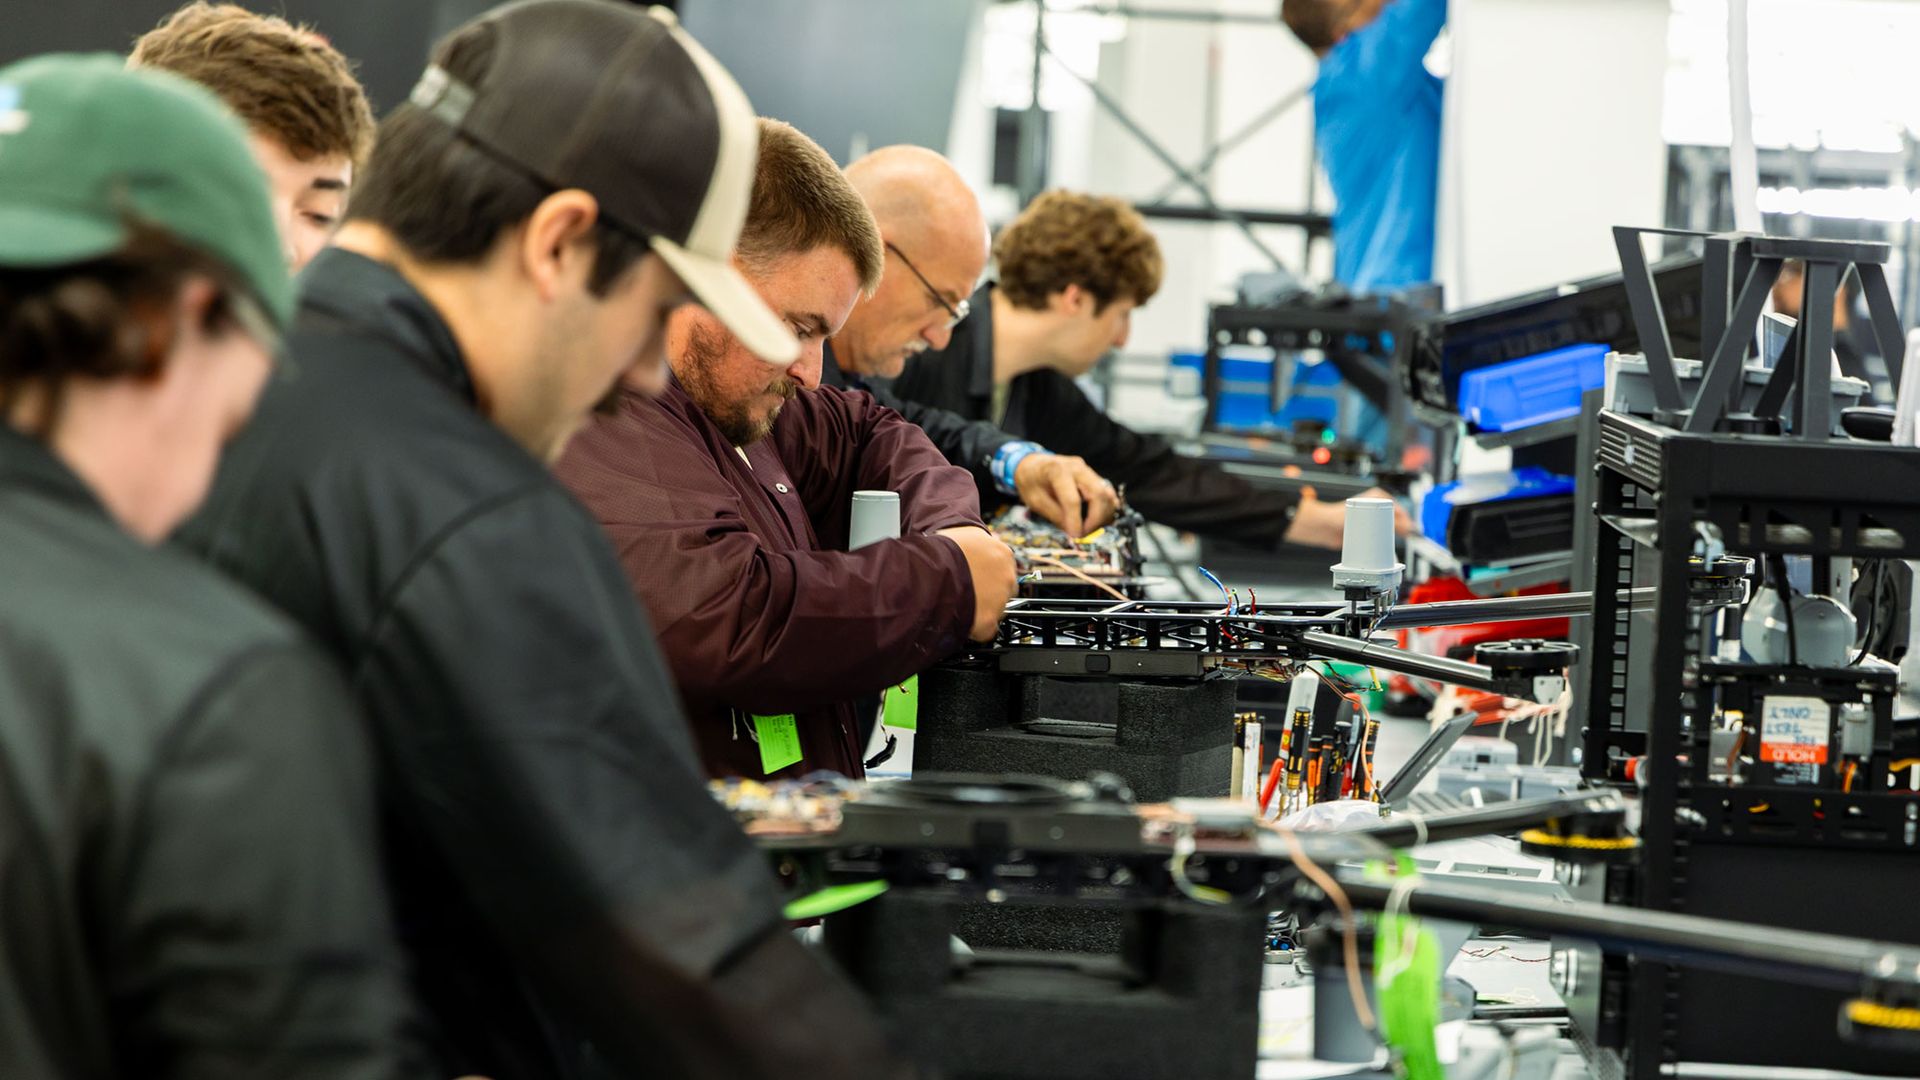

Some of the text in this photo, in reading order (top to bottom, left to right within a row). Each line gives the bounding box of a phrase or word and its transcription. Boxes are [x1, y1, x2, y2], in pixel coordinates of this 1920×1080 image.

[1771, 707, 1810, 719] ONLY
[1766, 722, 1802, 735] TEST
[1773, 750, 1816, 762] HOLD
